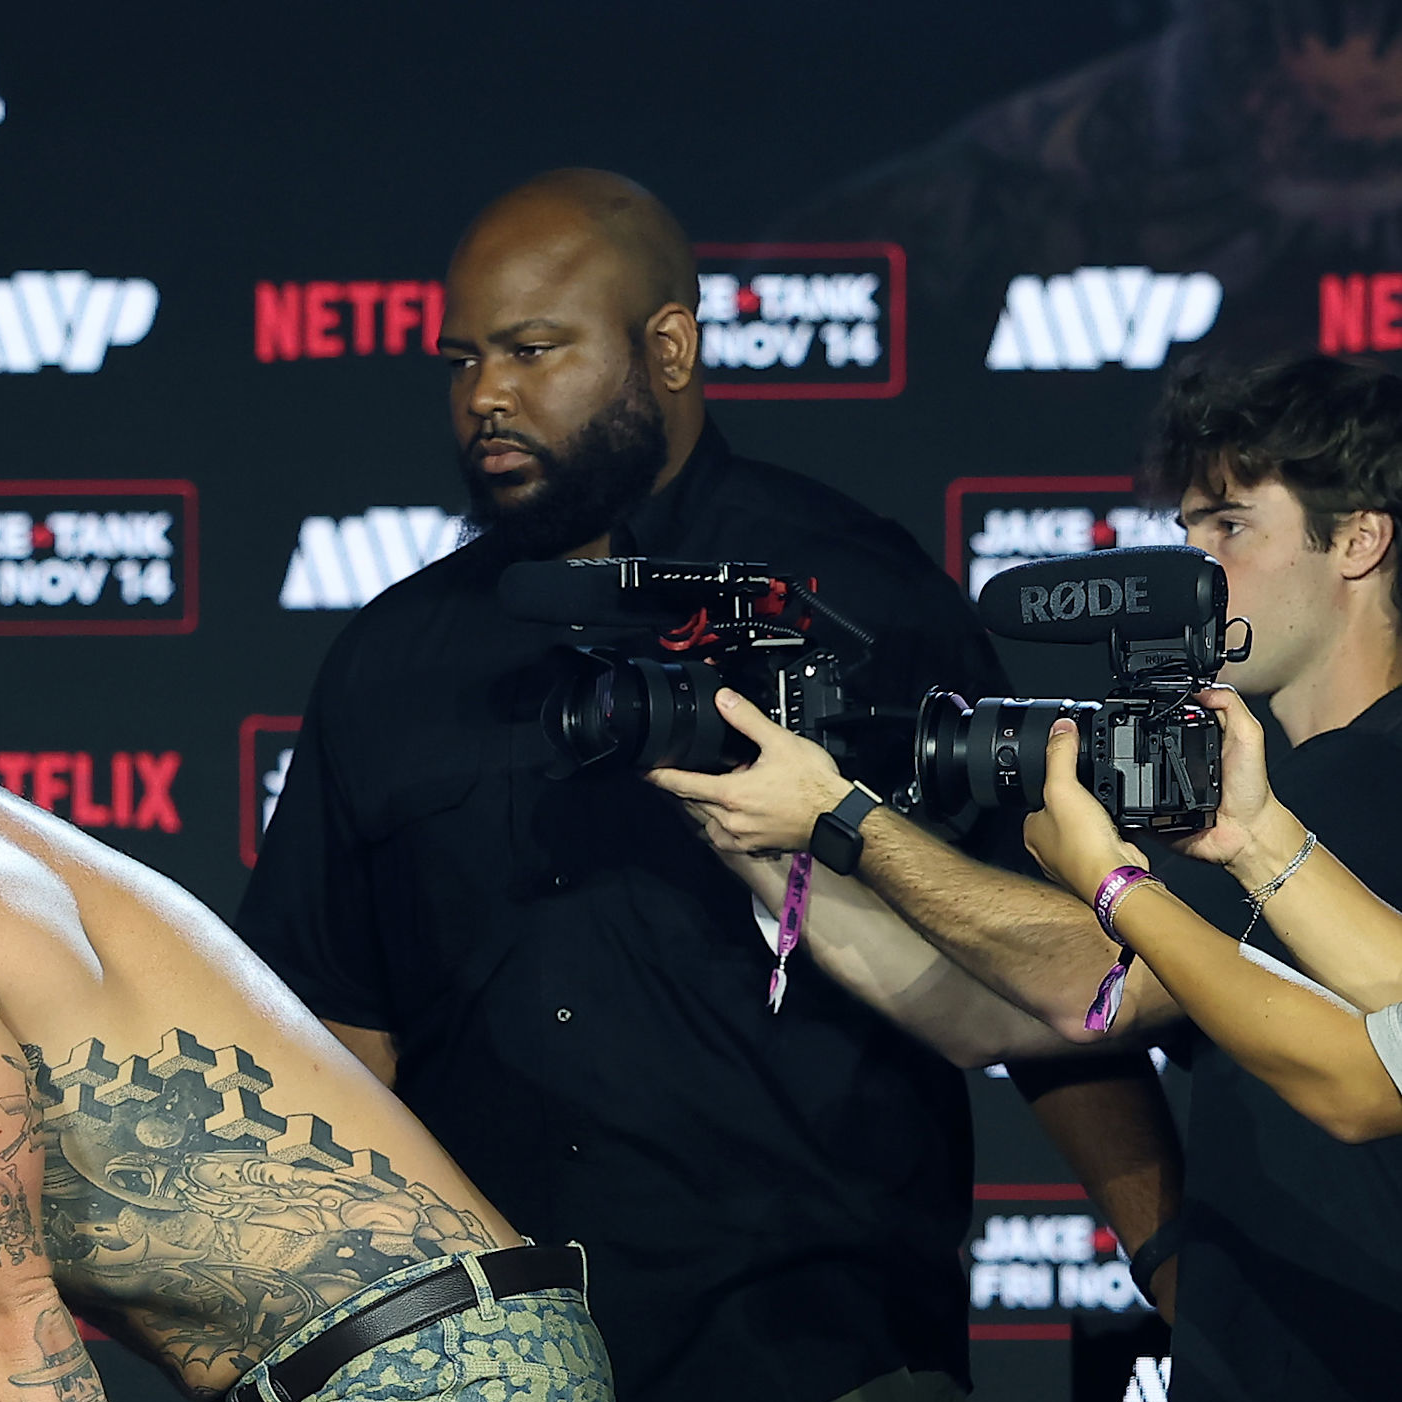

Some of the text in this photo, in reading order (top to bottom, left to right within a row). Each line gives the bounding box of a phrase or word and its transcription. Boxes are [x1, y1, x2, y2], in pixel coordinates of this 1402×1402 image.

[750, 274, 877, 322] TANK
[255, 281, 446, 362] NETFL
[701, 324, 878, 367] NOV 14
[46, 513, 170, 558] TANK
[972, 509, 1093, 555] JAKE
[116, 560, 172, 604] 14
[1020, 576, 1151, 625] RØDE
[1098, 874, 1128, 910] PRESS
[972, 1216, 1094, 1264] JAKE
[970, 1264, 1153, 1310] FRI NO
